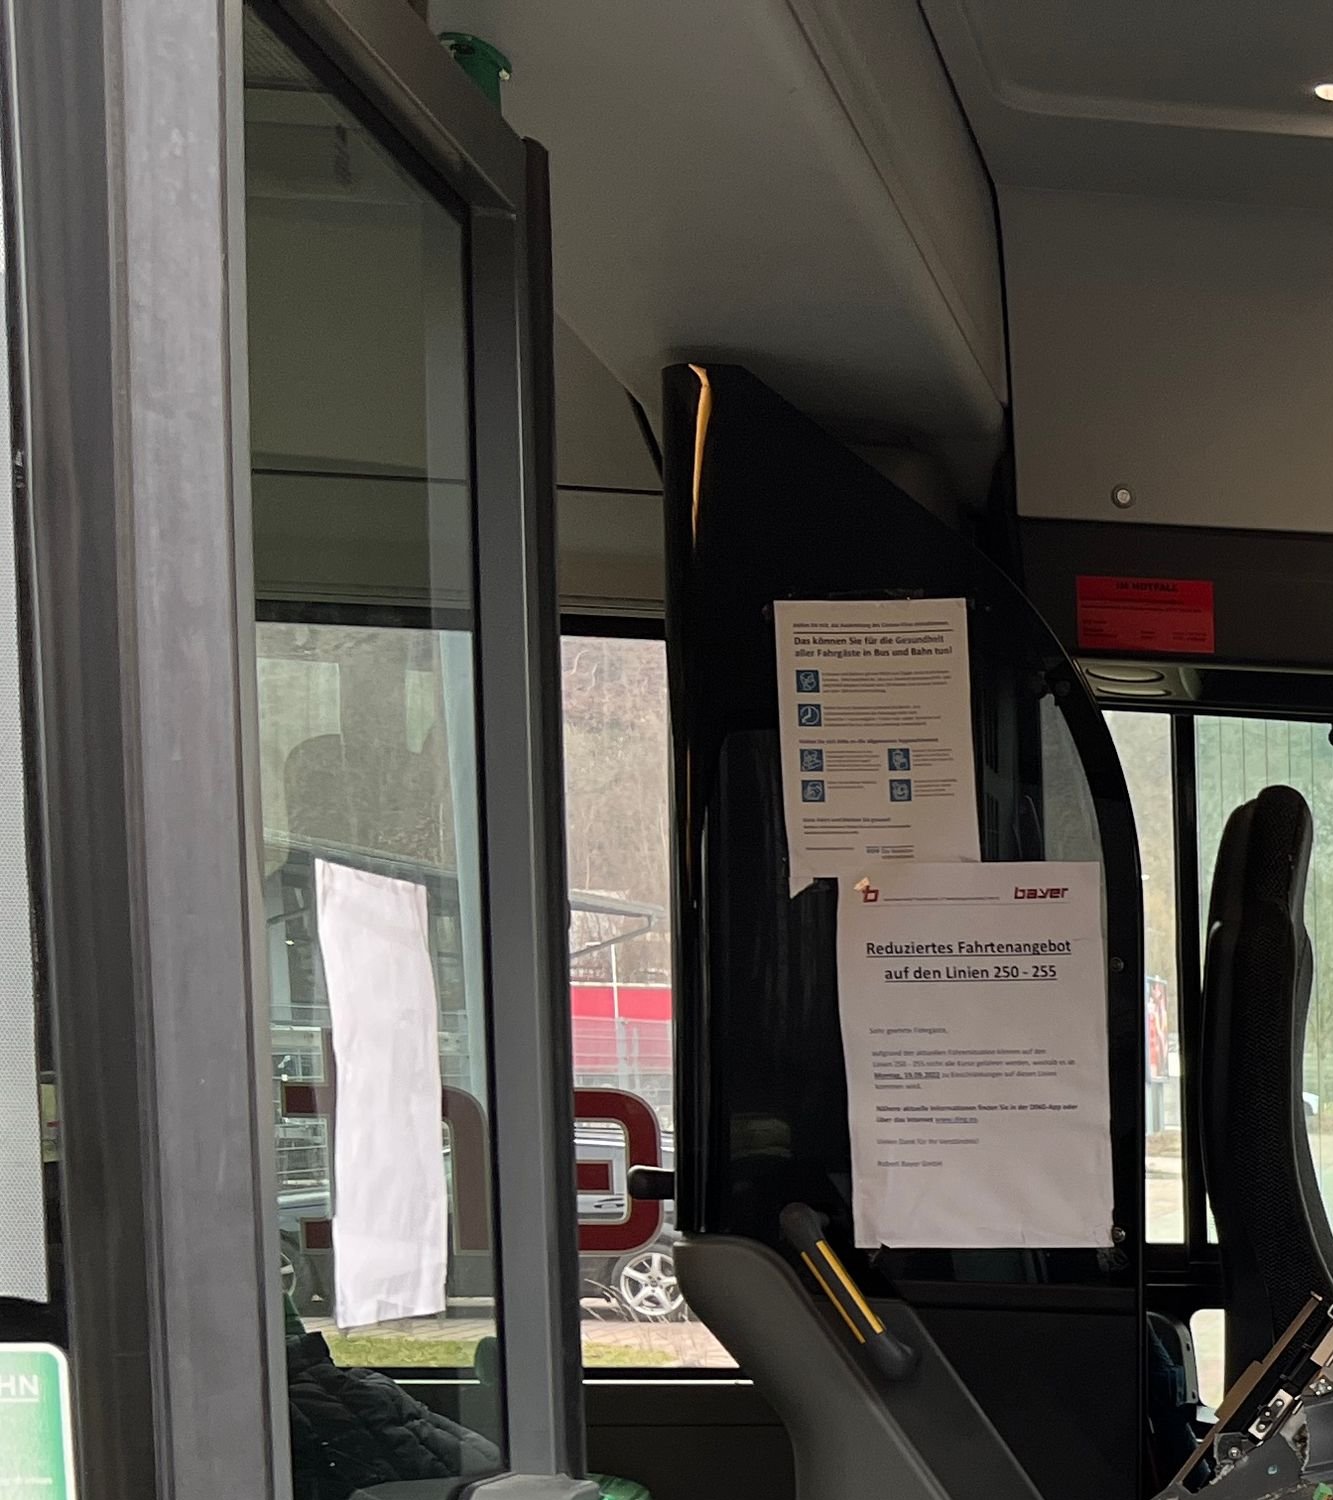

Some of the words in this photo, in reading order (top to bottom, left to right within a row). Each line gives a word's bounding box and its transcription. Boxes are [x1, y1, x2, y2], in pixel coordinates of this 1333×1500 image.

[794, 637, 811, 645] Das
[812, 636, 847, 645] können
[849, 636, 862, 645] Sie
[865, 636, 877, 645] für
[880, 635, 894, 644] die
[895, 634, 944, 644] Gesundheit
[795, 649, 814, 657] aller
[817, 648, 861, 658] Fahrgäste
[863, 648, 872, 657] in
[874, 648, 890, 657] Bus
[892, 647, 909, 656] und
[911, 646, 933, 656] Bahn
[1013, 886, 1069, 900] bayer
[866, 941, 953, 955] Reduziertes
[958, 939, 1071, 955] Fahrtenangebot
[884, 966, 909, 979] auf
[913, 966, 941, 979] den
[946, 965, 989, 979] Linien
[994, 965, 1019, 978] 250
[1032, 965, 1057, 977] 255
